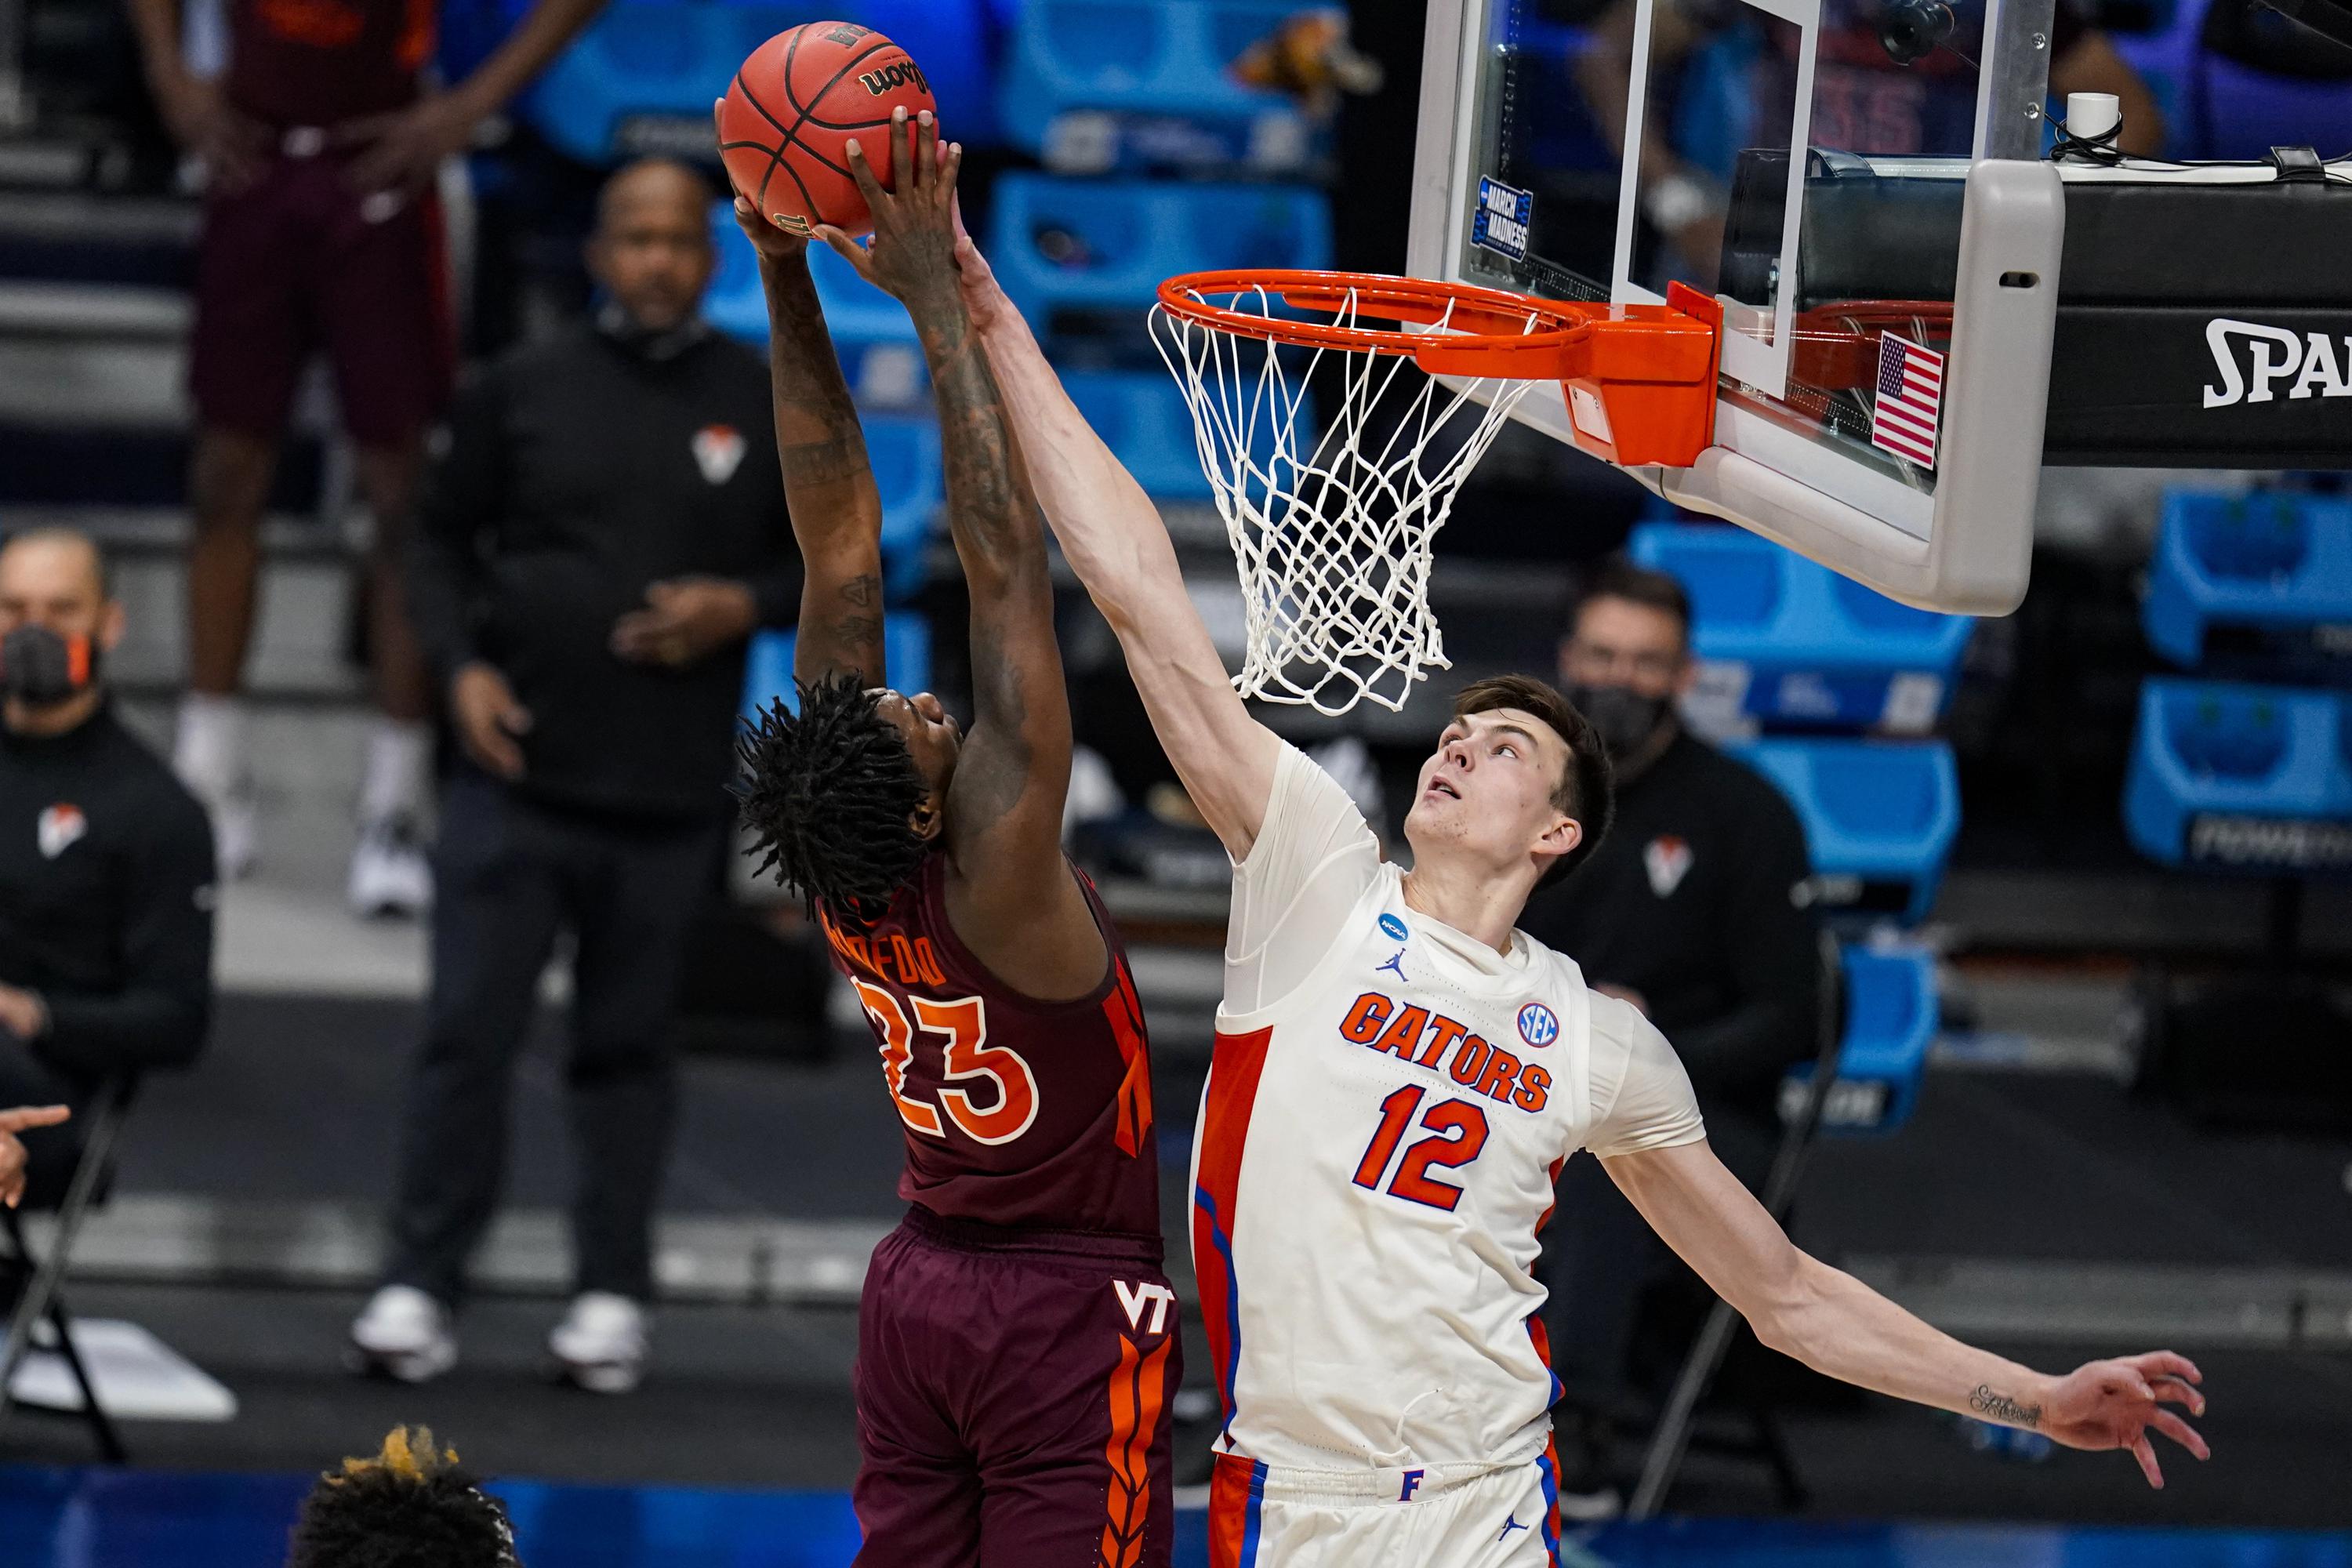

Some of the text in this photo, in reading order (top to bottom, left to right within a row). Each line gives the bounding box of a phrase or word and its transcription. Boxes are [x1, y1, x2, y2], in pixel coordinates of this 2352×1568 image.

[1486, 184, 1517, 220] MARCH
[1488, 212, 1527, 251] MADNESS
[2203, 318, 2352, 409] SPA
[1381, 920, 1406, 939] NCAA
[1521, 1005, 1555, 1044] SEC
[851, 975, 1040, 1145] 23
[1339, 992, 1552, 1113] GATORS
[1352, 1083, 1490, 1212] 12
[1112, 1278, 1178, 1334] VT
[1397, 1469, 1425, 1501] F
